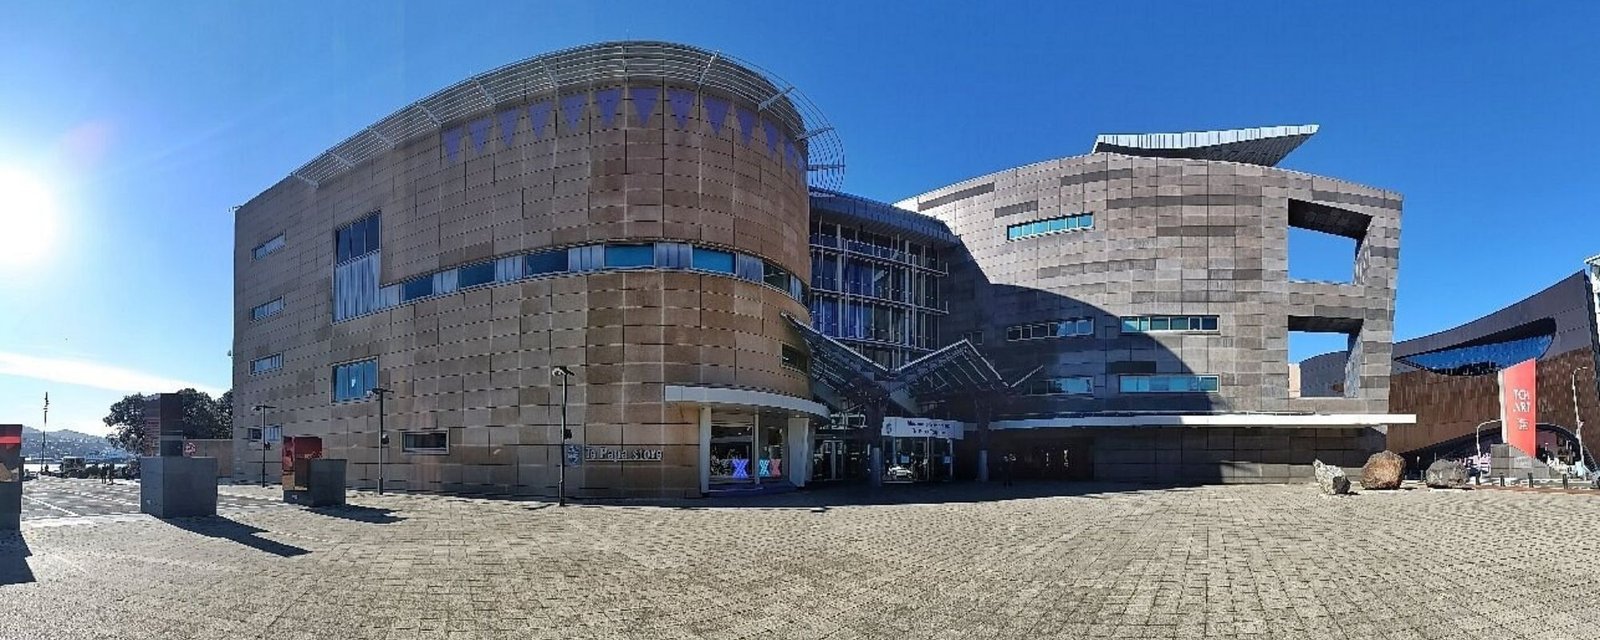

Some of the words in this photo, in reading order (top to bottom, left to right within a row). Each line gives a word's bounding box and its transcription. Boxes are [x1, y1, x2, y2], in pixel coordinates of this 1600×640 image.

[1513, 401, 1530, 413] ART
[585, 447, 595, 459] Te
[600, 447, 628, 462] Papa
[632, 447, 663, 459] store
